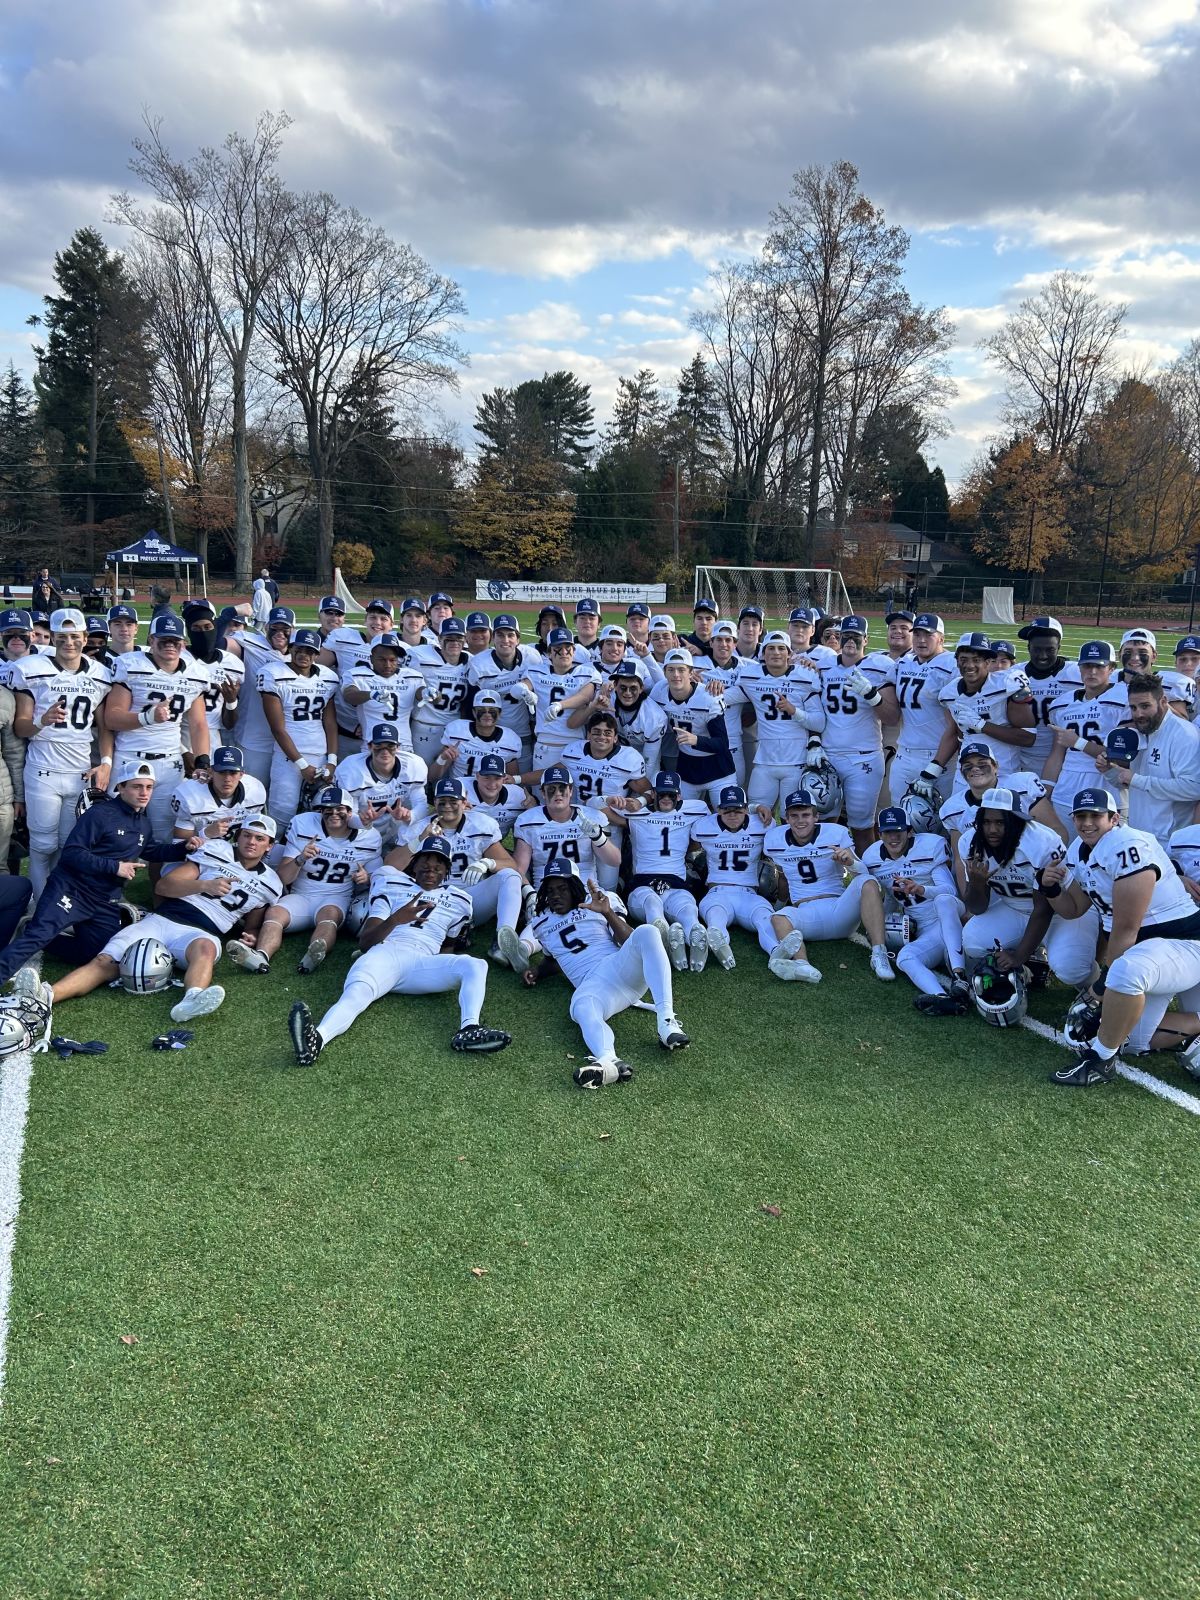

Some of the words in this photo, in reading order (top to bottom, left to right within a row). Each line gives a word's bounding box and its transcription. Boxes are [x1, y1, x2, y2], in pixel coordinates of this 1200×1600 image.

[146, 682, 174, 691] MALVERN
[495, 681, 517, 689] MALVERN
[899, 677, 925, 709] 77
[293, 696, 325, 721] 22
[433, 683, 467, 711] 52
[761, 694, 792, 720] 31
[827, 683, 857, 714] 55
[55, 695, 91, 729] 10
[465, 748, 487, 757] MALVERN
[1151, 748, 1160, 762] MP
[577, 766, 597, 775] MALVERN
[863, 763, 872, 776] MP
[579, 774, 603, 800] 21
[543, 840, 580, 863] 79
[660, 827, 671, 856] 1
[718, 851, 749, 871] 15
[1117, 847, 1140, 869] 78
[307, 858, 350, 883] 32
[798, 860, 818, 884] 9
[878, 872, 901, 881] MALVERN
[244, 884, 258, 895] PREP
[438, 897, 452, 908] PREP
[410, 900, 437, 930] 7
[548, 920, 569, 935] MALVERN
[571, 914, 587, 923] PREP
[559, 925, 589, 954] 5
